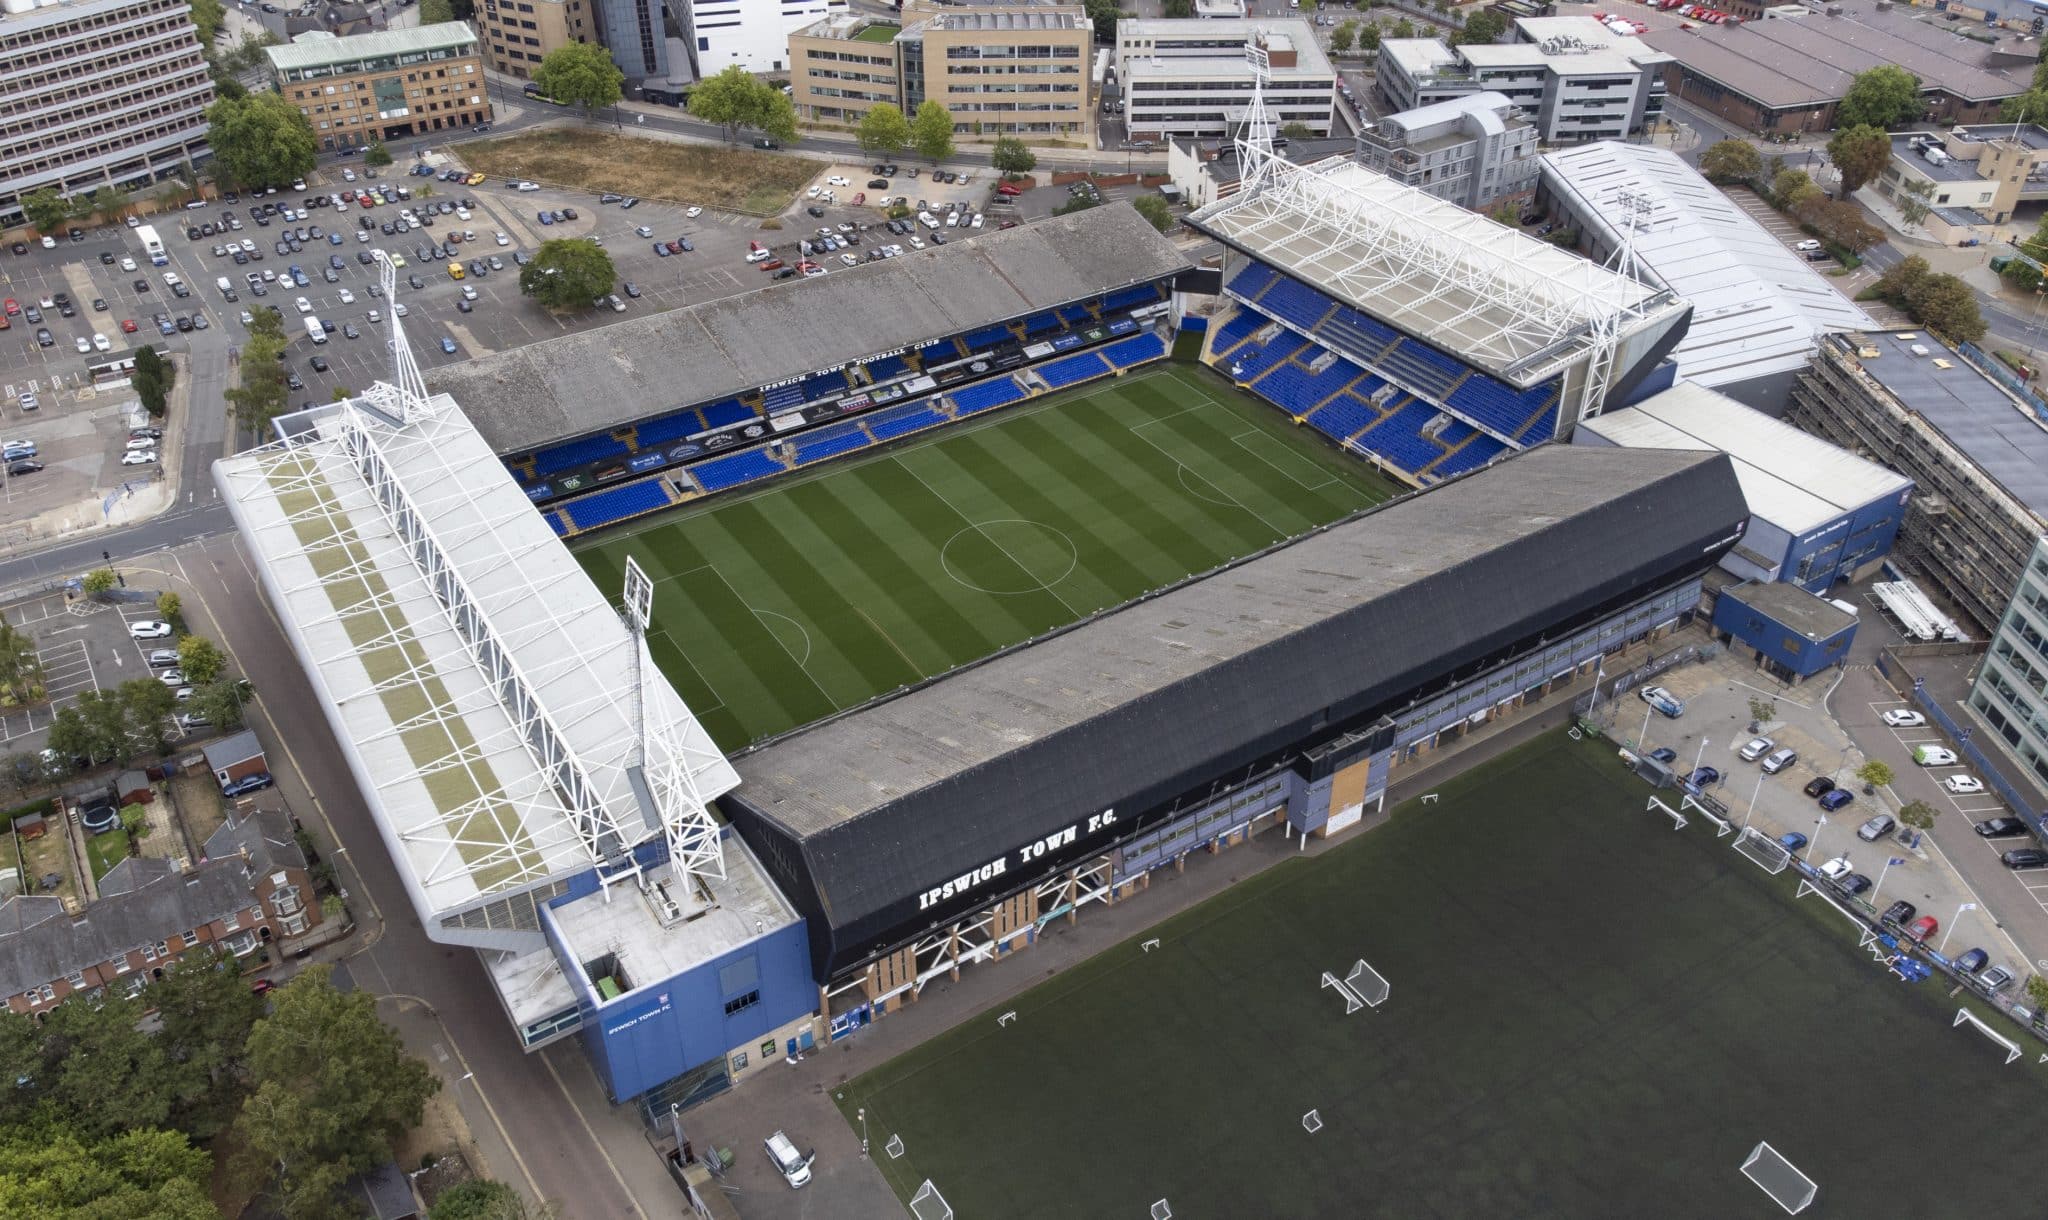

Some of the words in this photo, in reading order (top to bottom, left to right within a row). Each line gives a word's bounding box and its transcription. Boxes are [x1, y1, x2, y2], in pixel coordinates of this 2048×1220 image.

[760, 375, 806, 391] IPSWICH
[816, 364, 846, 376] TOWN
[856, 348, 905, 365] FOOTBALL
[914, 339, 939, 350] CLUB
[919, 857, 1006, 910] IPSWICH
[1020, 825, 1077, 863] TOWN
[1088, 808, 1117, 833] F.C.
[608, 1019, 638, 1035] IPSWICH
[638, 1008, 661, 1021] TOWN
[662, 1003, 671, 1011] FC
